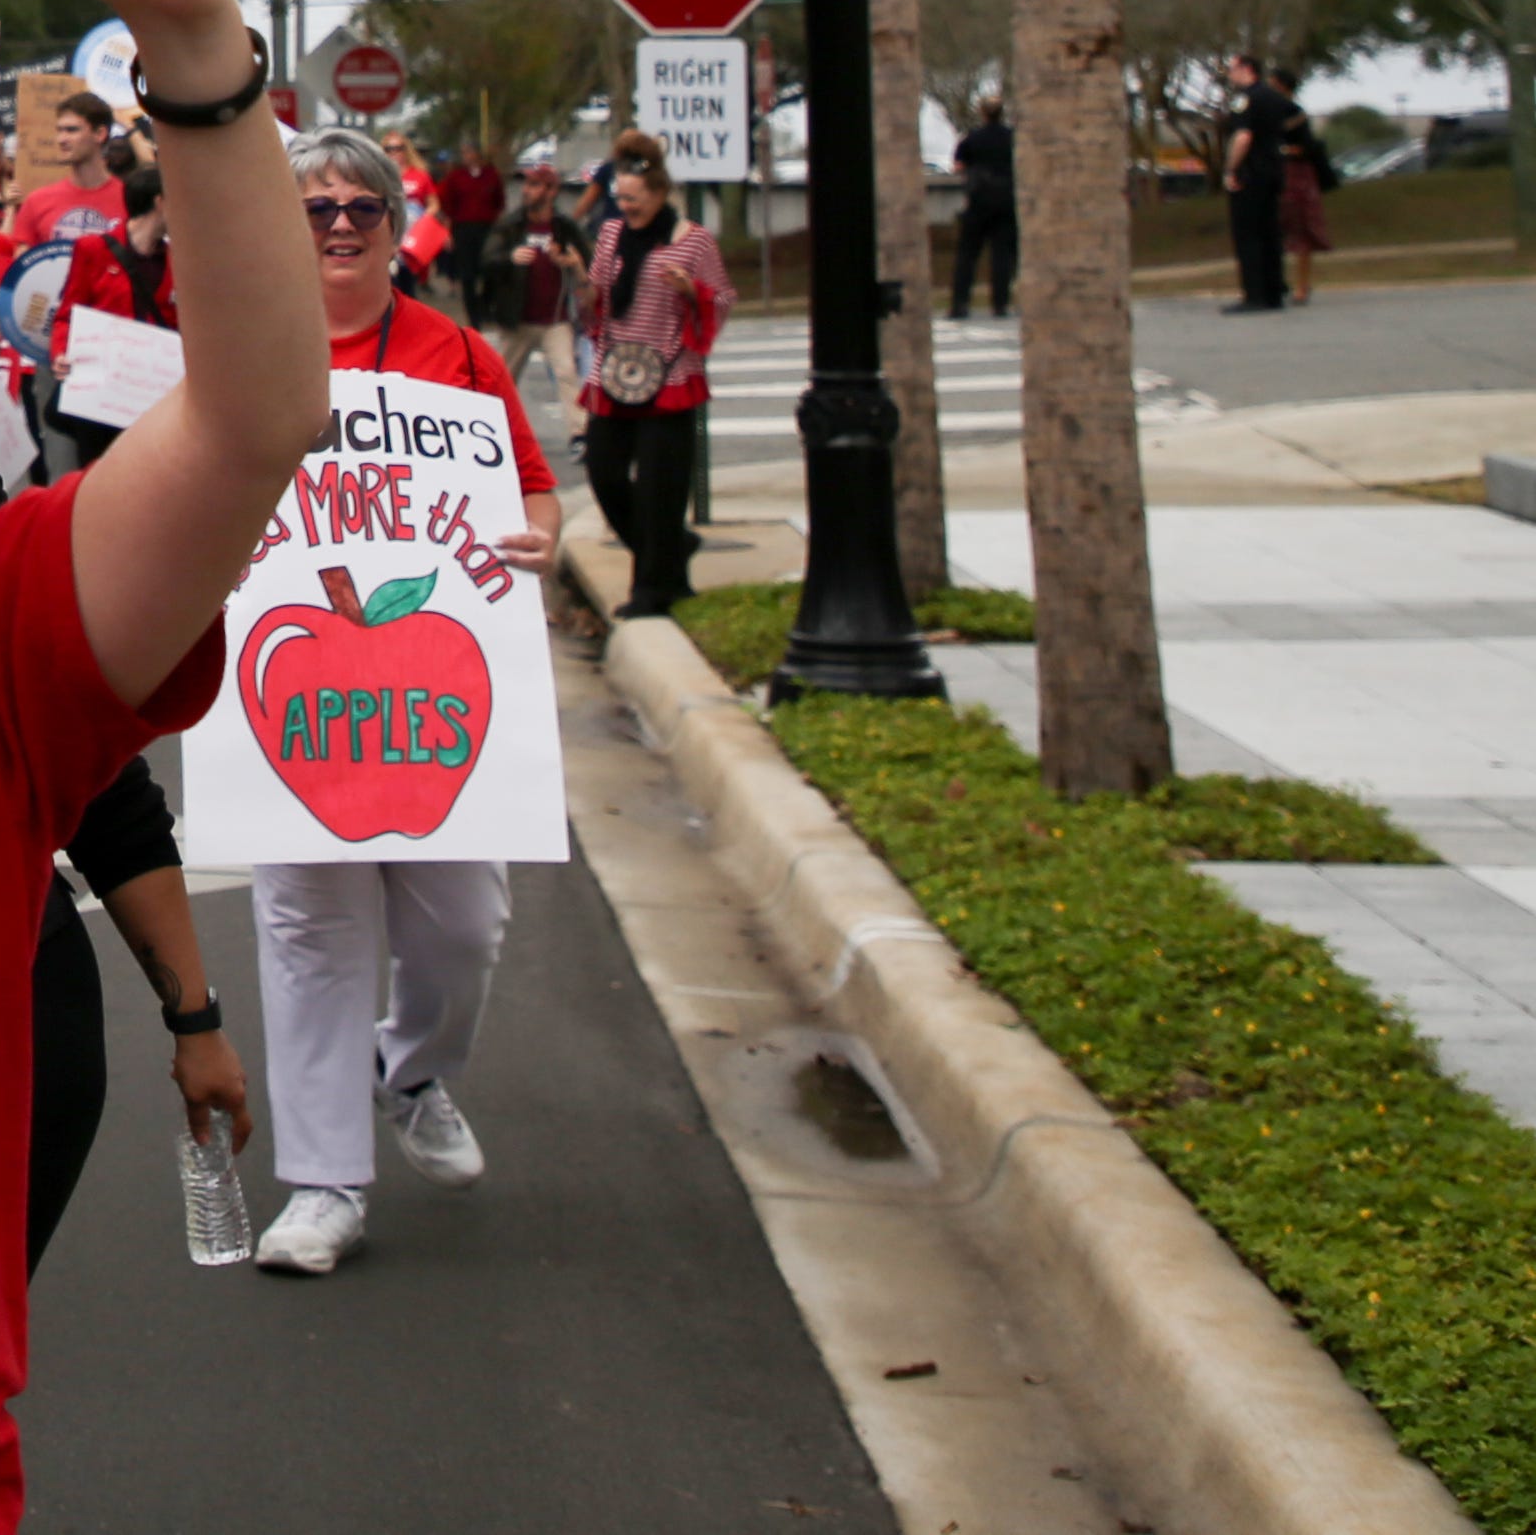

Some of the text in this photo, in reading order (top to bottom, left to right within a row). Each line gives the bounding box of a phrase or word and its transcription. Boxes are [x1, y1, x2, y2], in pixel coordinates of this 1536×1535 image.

[654, 59, 727, 86] RIGHT
[658, 95, 724, 120] TURN
[295, 461, 513, 603] MORE than
[281, 688, 471, 768] APPLES
